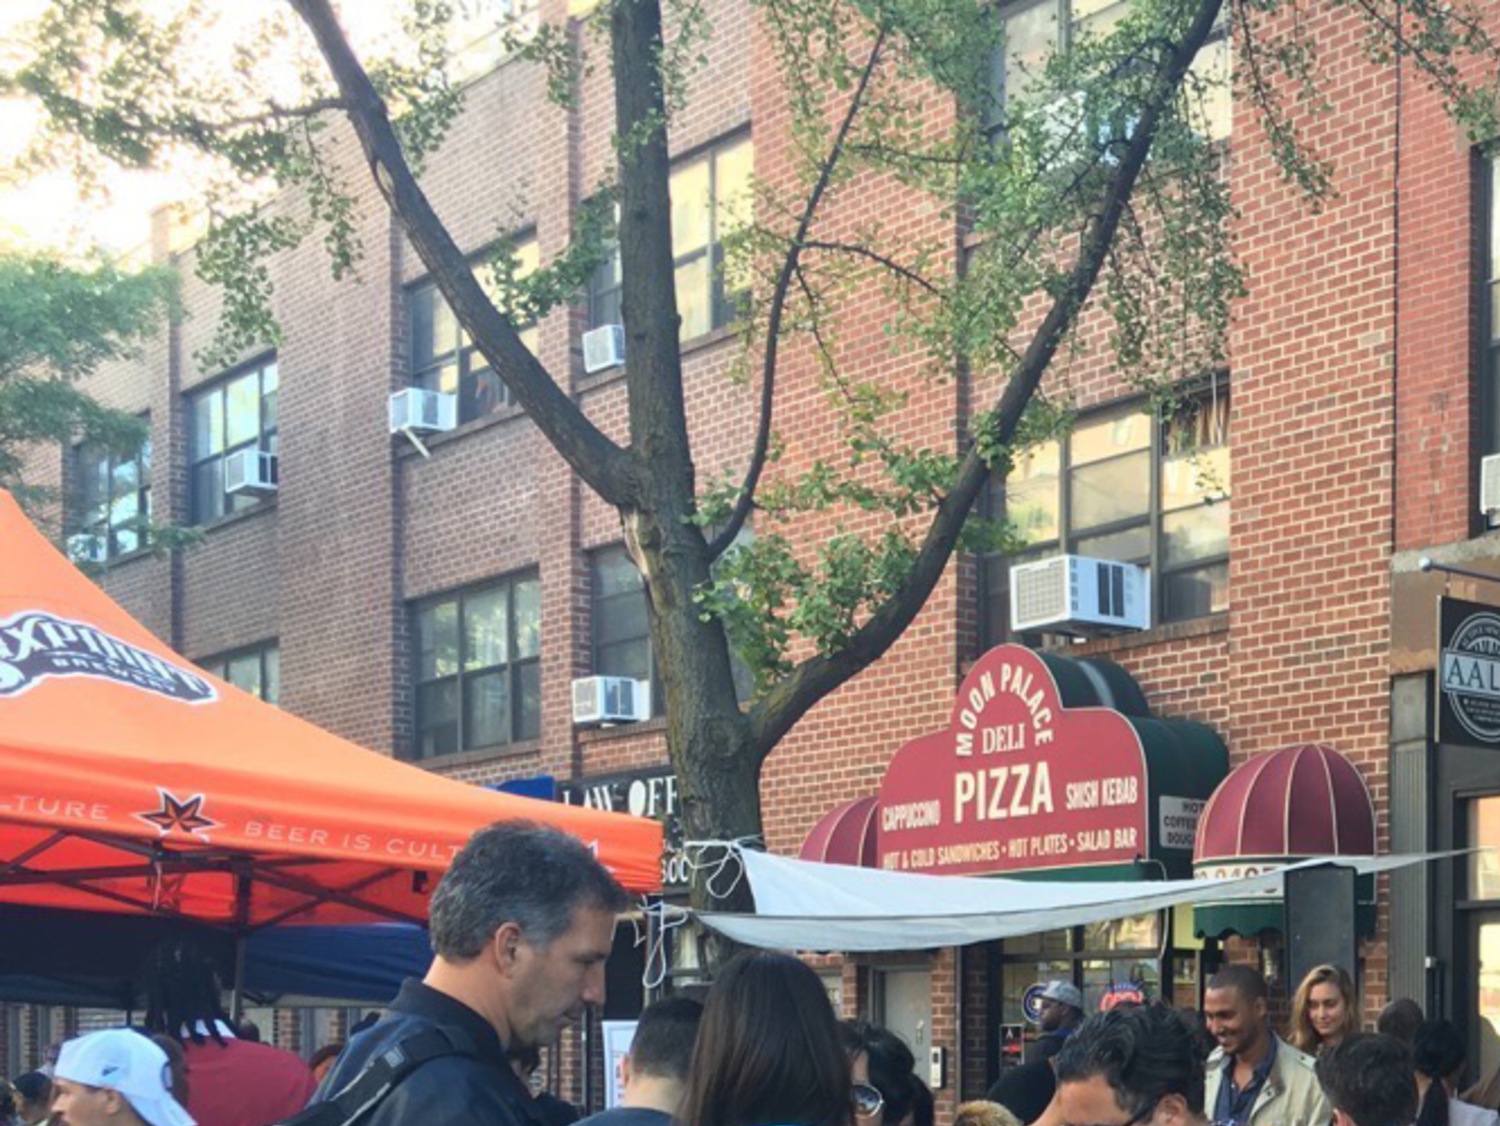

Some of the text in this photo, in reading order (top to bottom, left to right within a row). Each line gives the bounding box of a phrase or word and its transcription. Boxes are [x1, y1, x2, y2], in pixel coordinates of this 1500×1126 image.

[956, 663, 1053, 757] MOON PALACE
[982, 723, 1026, 754] DELI
[954, 761, 1054, 823] PIZZA
[1066, 776, 1138, 810] SHISH KEBAB
[0, 794, 109, 821] TURE
[244, 821, 326, 846] BEER
[343, 832, 372, 851] IS
[883, 852, 900, 870] HOT
[911, 848, 934, 868] COLD
[938, 841, 999, 866] SANDWICHES
[1008, 838, 1028, 858] HOT
[1030, 833, 1067, 856] PLATES
[1077, 829, 1111, 852] SALAD
[1114, 827, 1137, 849] BAR
